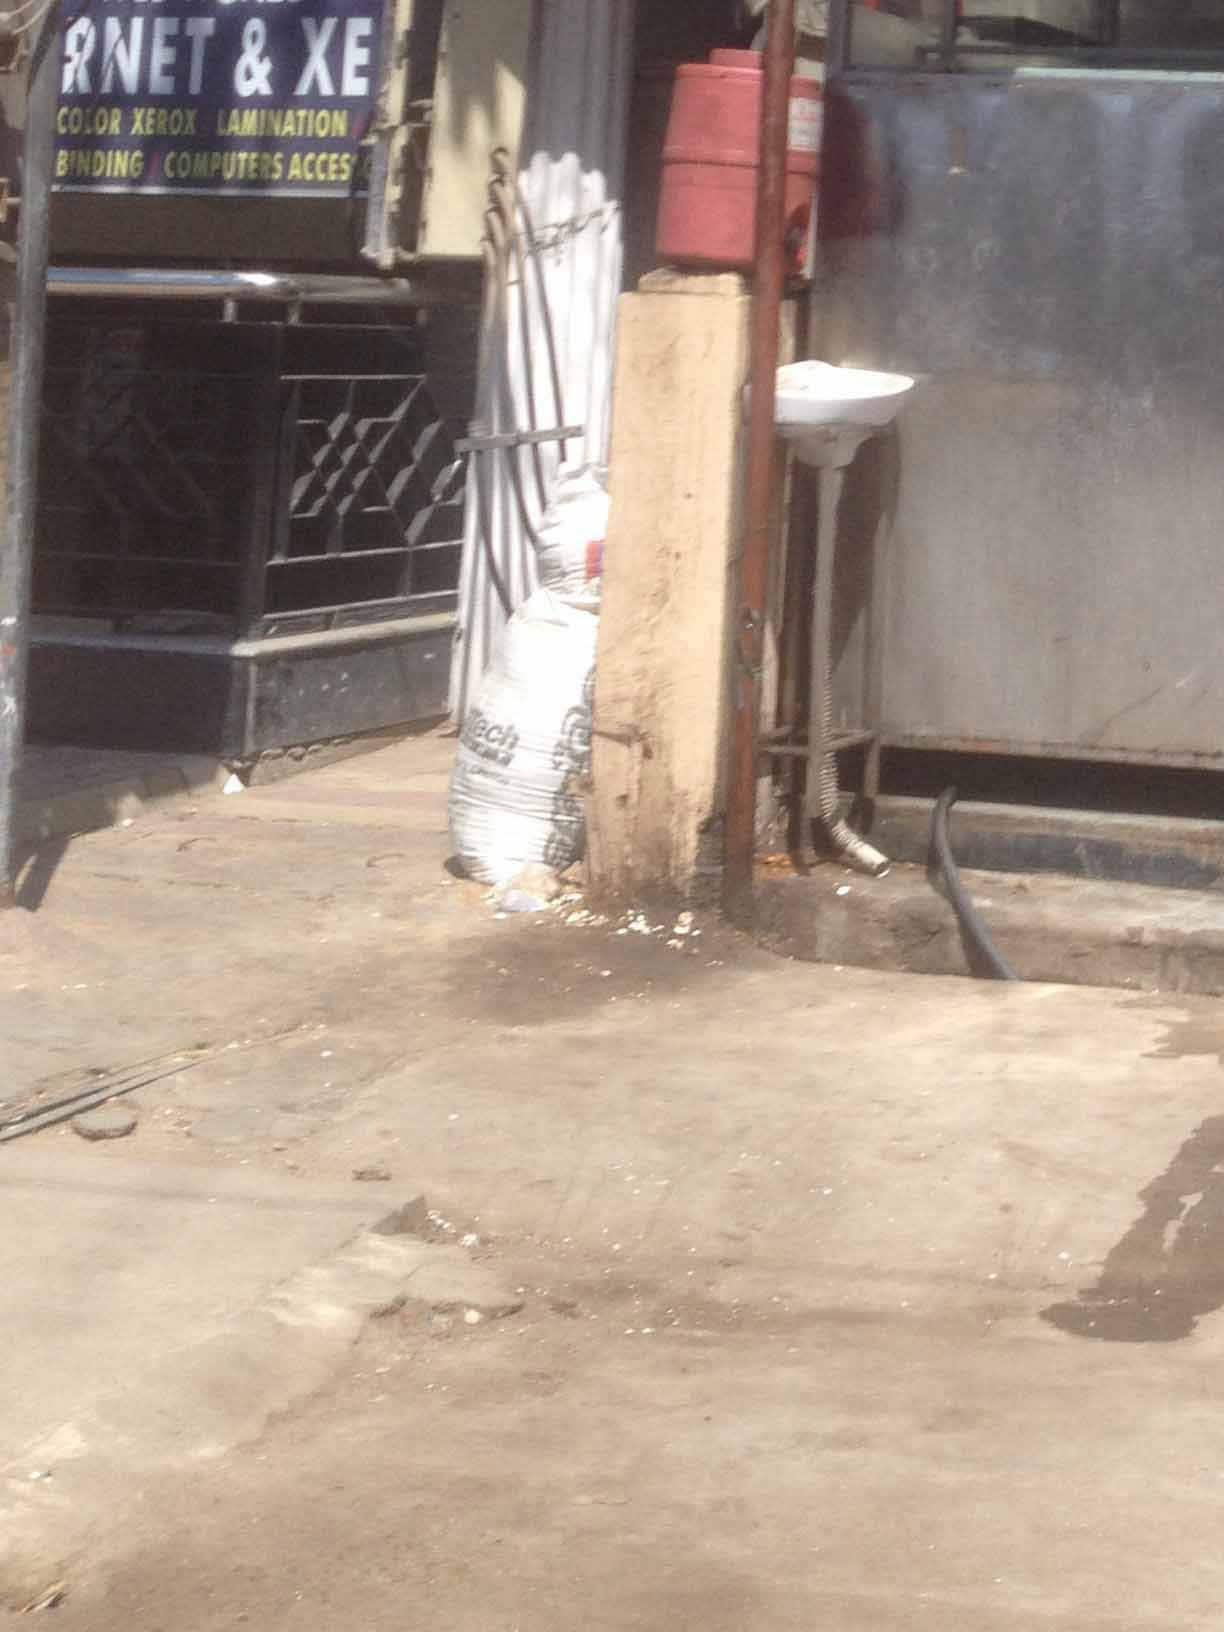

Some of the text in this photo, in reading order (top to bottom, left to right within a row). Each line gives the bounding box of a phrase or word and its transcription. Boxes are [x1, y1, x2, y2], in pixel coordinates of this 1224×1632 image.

[234, 18, 272, 97] &
[130, 108, 196, 136] XEROX
[217, 109, 348, 137] LAMINATION
[55, 149, 145, 178] BINDING
[163, 152, 283, 180] COMPUTERS
